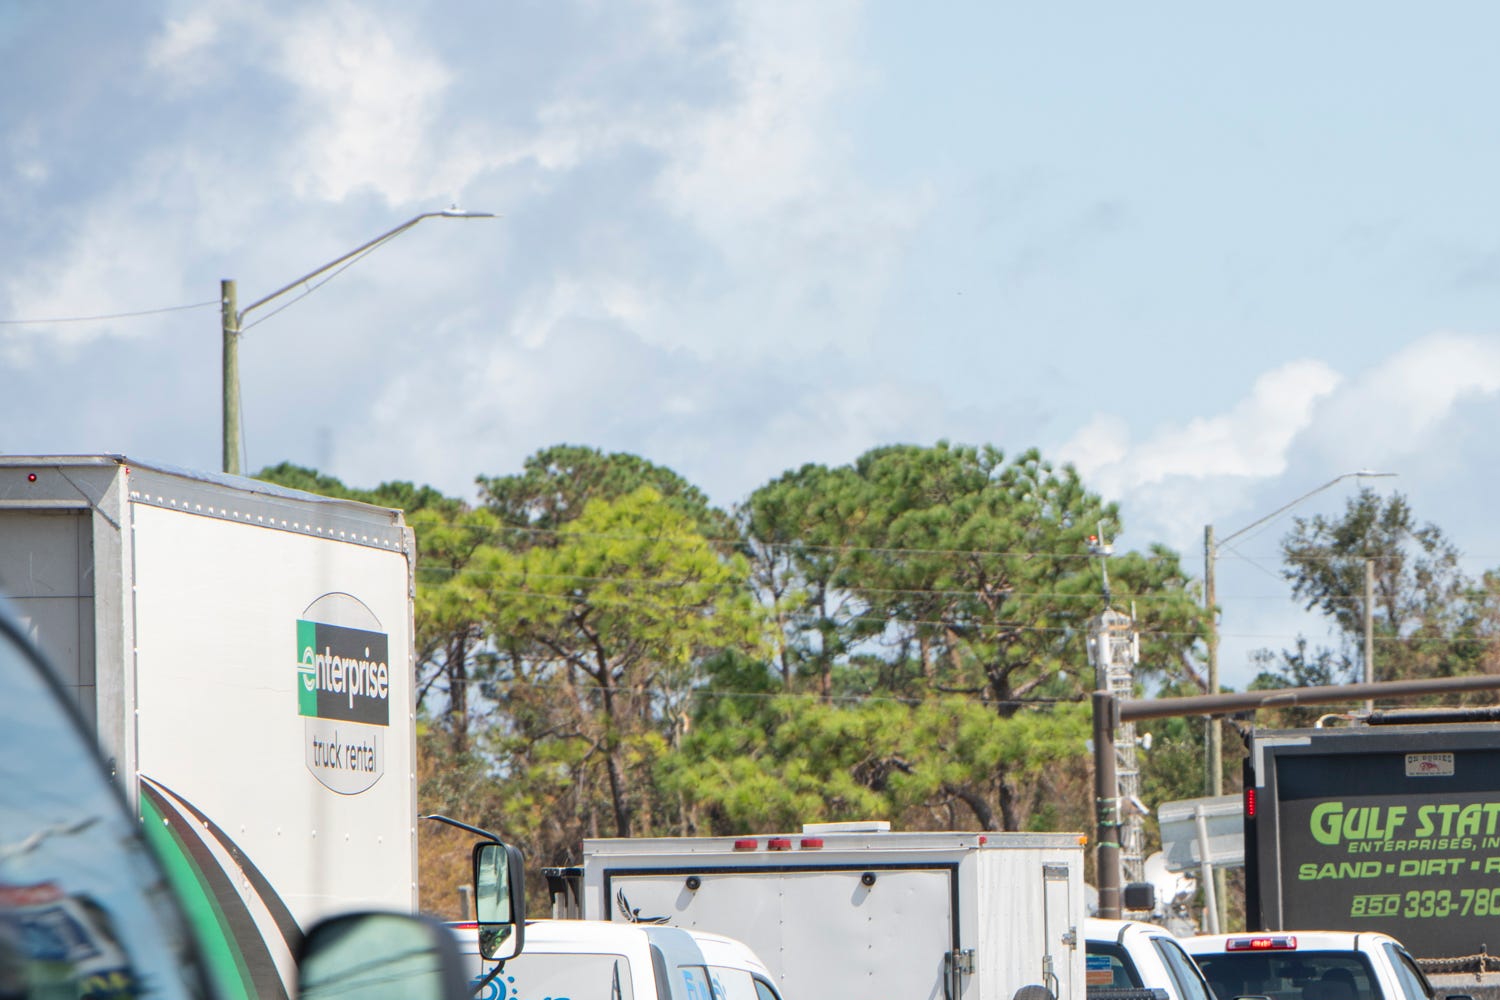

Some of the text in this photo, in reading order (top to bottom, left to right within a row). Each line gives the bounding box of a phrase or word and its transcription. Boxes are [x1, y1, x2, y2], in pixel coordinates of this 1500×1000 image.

[299, 646, 389, 709] enterprise
[313, 731, 376, 773] truck rental
[1310, 801, 1407, 845] GULF
[1347, 837, 1477, 853] ENTERPRISES,
[1298, 861, 1382, 880] SAND
[1399, 857, 1466, 877] DIRT
[1350, 894, 1401, 917] 850
